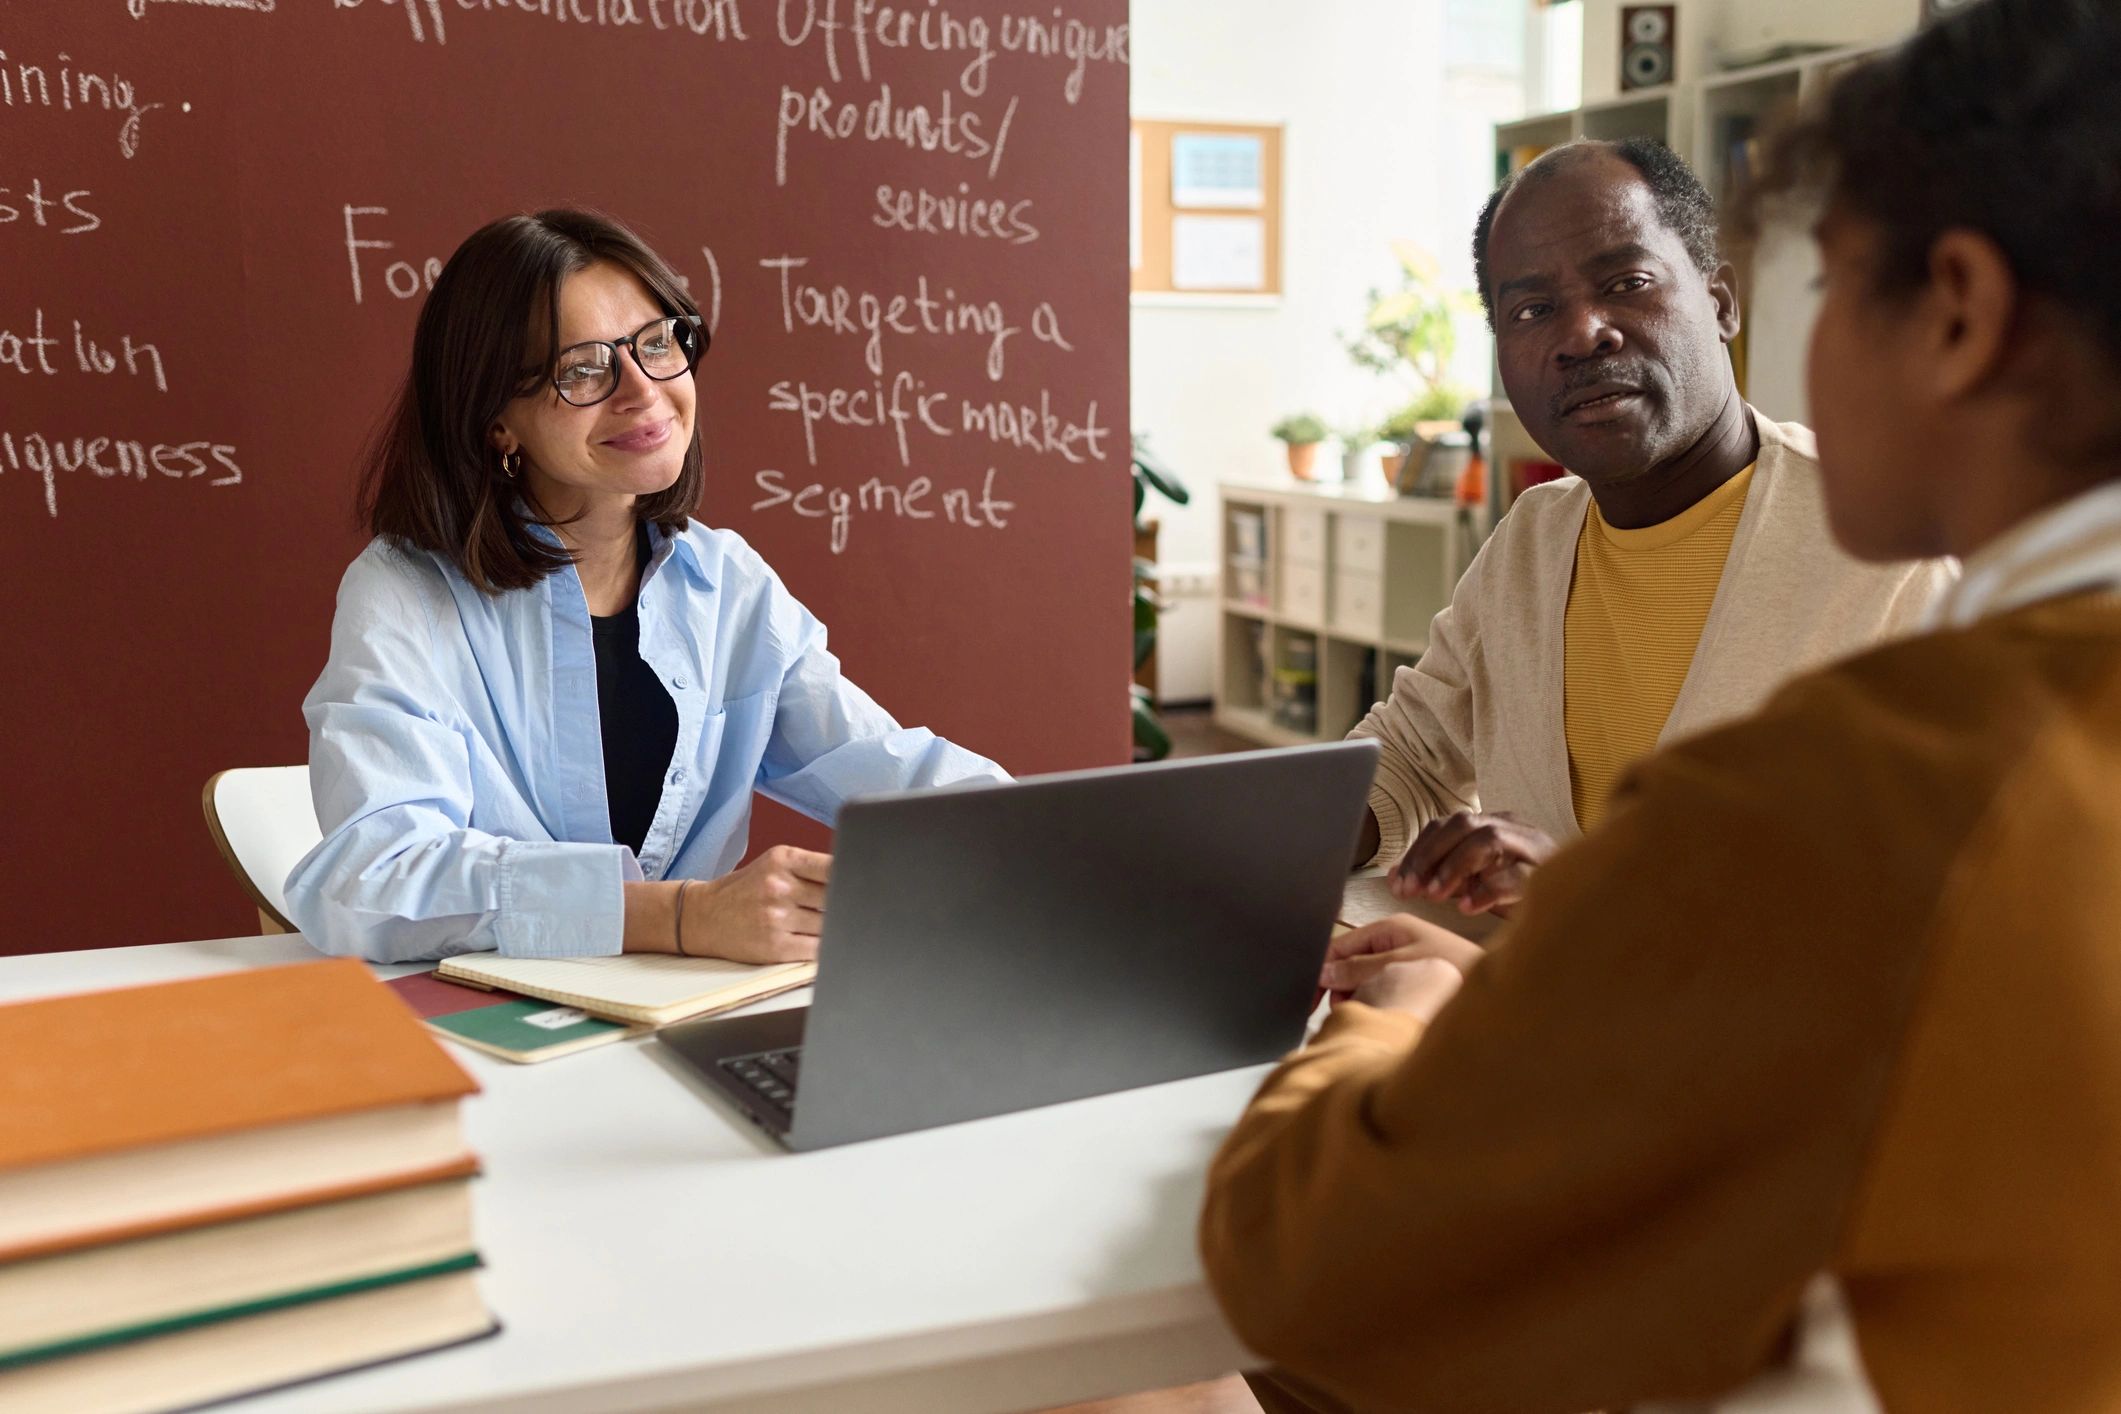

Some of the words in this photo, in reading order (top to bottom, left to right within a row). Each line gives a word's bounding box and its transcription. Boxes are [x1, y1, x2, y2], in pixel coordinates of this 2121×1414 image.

[777, 0, 997, 97] Offering
[872, 182, 1040, 244] services
[759, 256, 1021, 382] Targeting
[1032, 302, 1074, 352] a
[768, 371, 953, 466] specific
[962, 389, 1110, 463] market
[0, 432, 242, 518] iqueness
